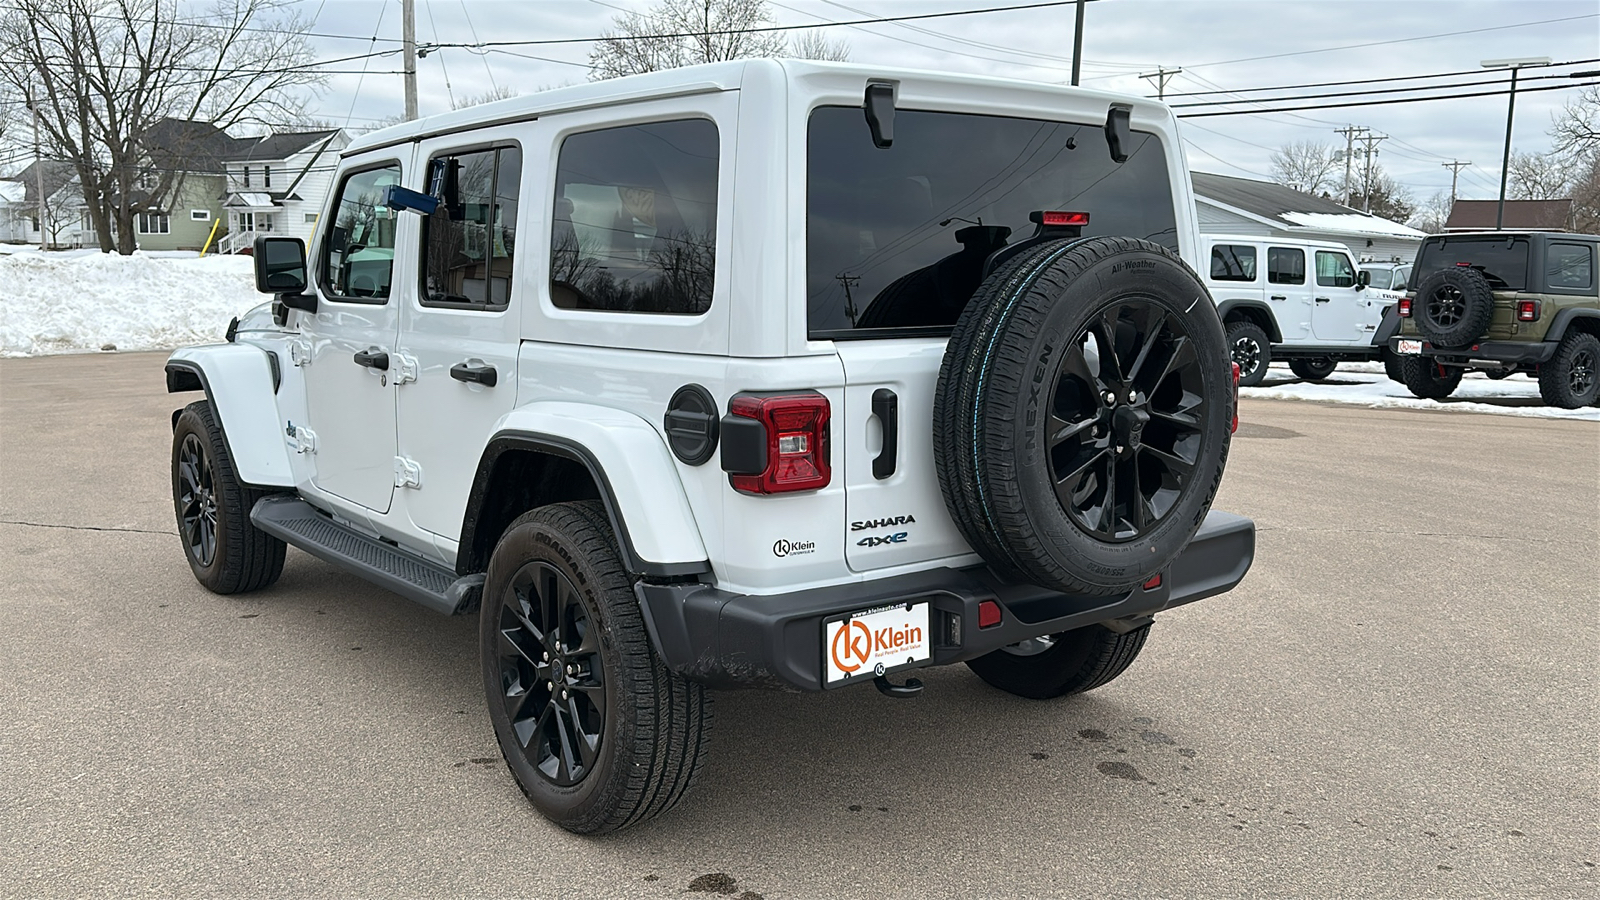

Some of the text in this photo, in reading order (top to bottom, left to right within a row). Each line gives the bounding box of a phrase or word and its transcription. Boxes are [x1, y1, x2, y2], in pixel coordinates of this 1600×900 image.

[1111, 260, 1156, 274] All-Weather
[1025, 343, 1053, 450] NEXEN
[1219, 358, 1232, 464] ROADIAN
[851, 514, 916, 531] SAHARA
[791, 541, 815, 551] Klein
[535, 532, 587, 586] ROADIAN
[852, 602, 907, 618] www.kleinauto.com
[874, 623, 922, 652] Klein
